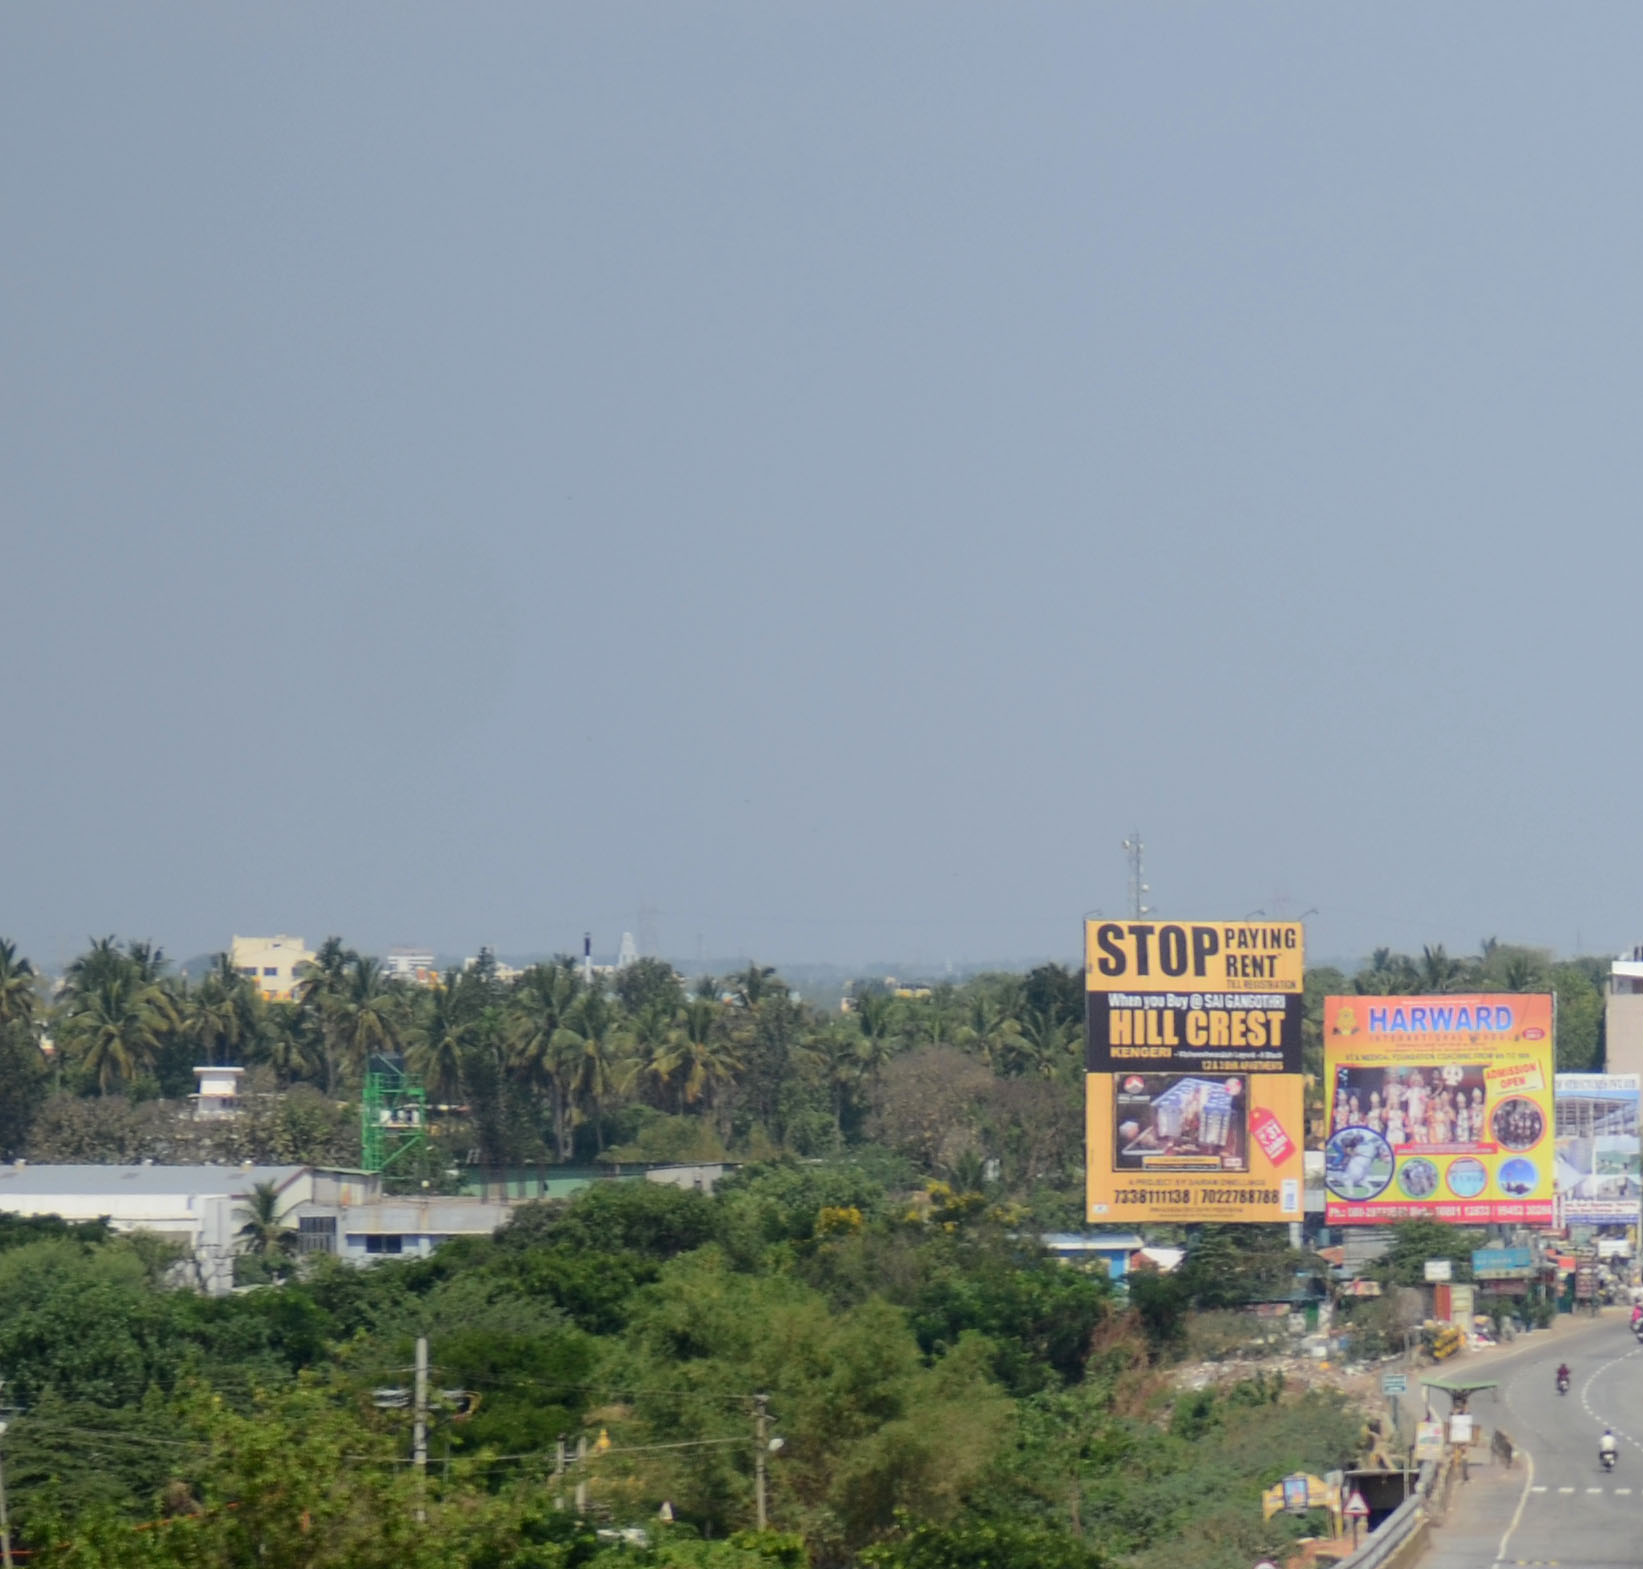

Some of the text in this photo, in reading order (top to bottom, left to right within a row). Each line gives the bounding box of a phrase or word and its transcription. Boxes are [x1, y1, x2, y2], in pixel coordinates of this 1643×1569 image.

[1224, 928, 1297, 949] PAYING
[1097, 923, 1219, 977] STOP
[1108, 993, 1142, 1008] When
[1143, 995, 1165, 1010] you
[1167, 994, 1189, 1010] Buy
[1189, 994, 1203, 1009] @
[1205, 995, 1224, 1008] SAI
[1109, 1009, 1286, 1046] HILL CREST
[1369, 1006, 1513, 1032] HARWARD
[1110, 1047, 1172, 1058] KENGERI
[1486, 1063, 1537, 1080] ADMISSION
[1500, 1077, 1526, 1088] OPEN
